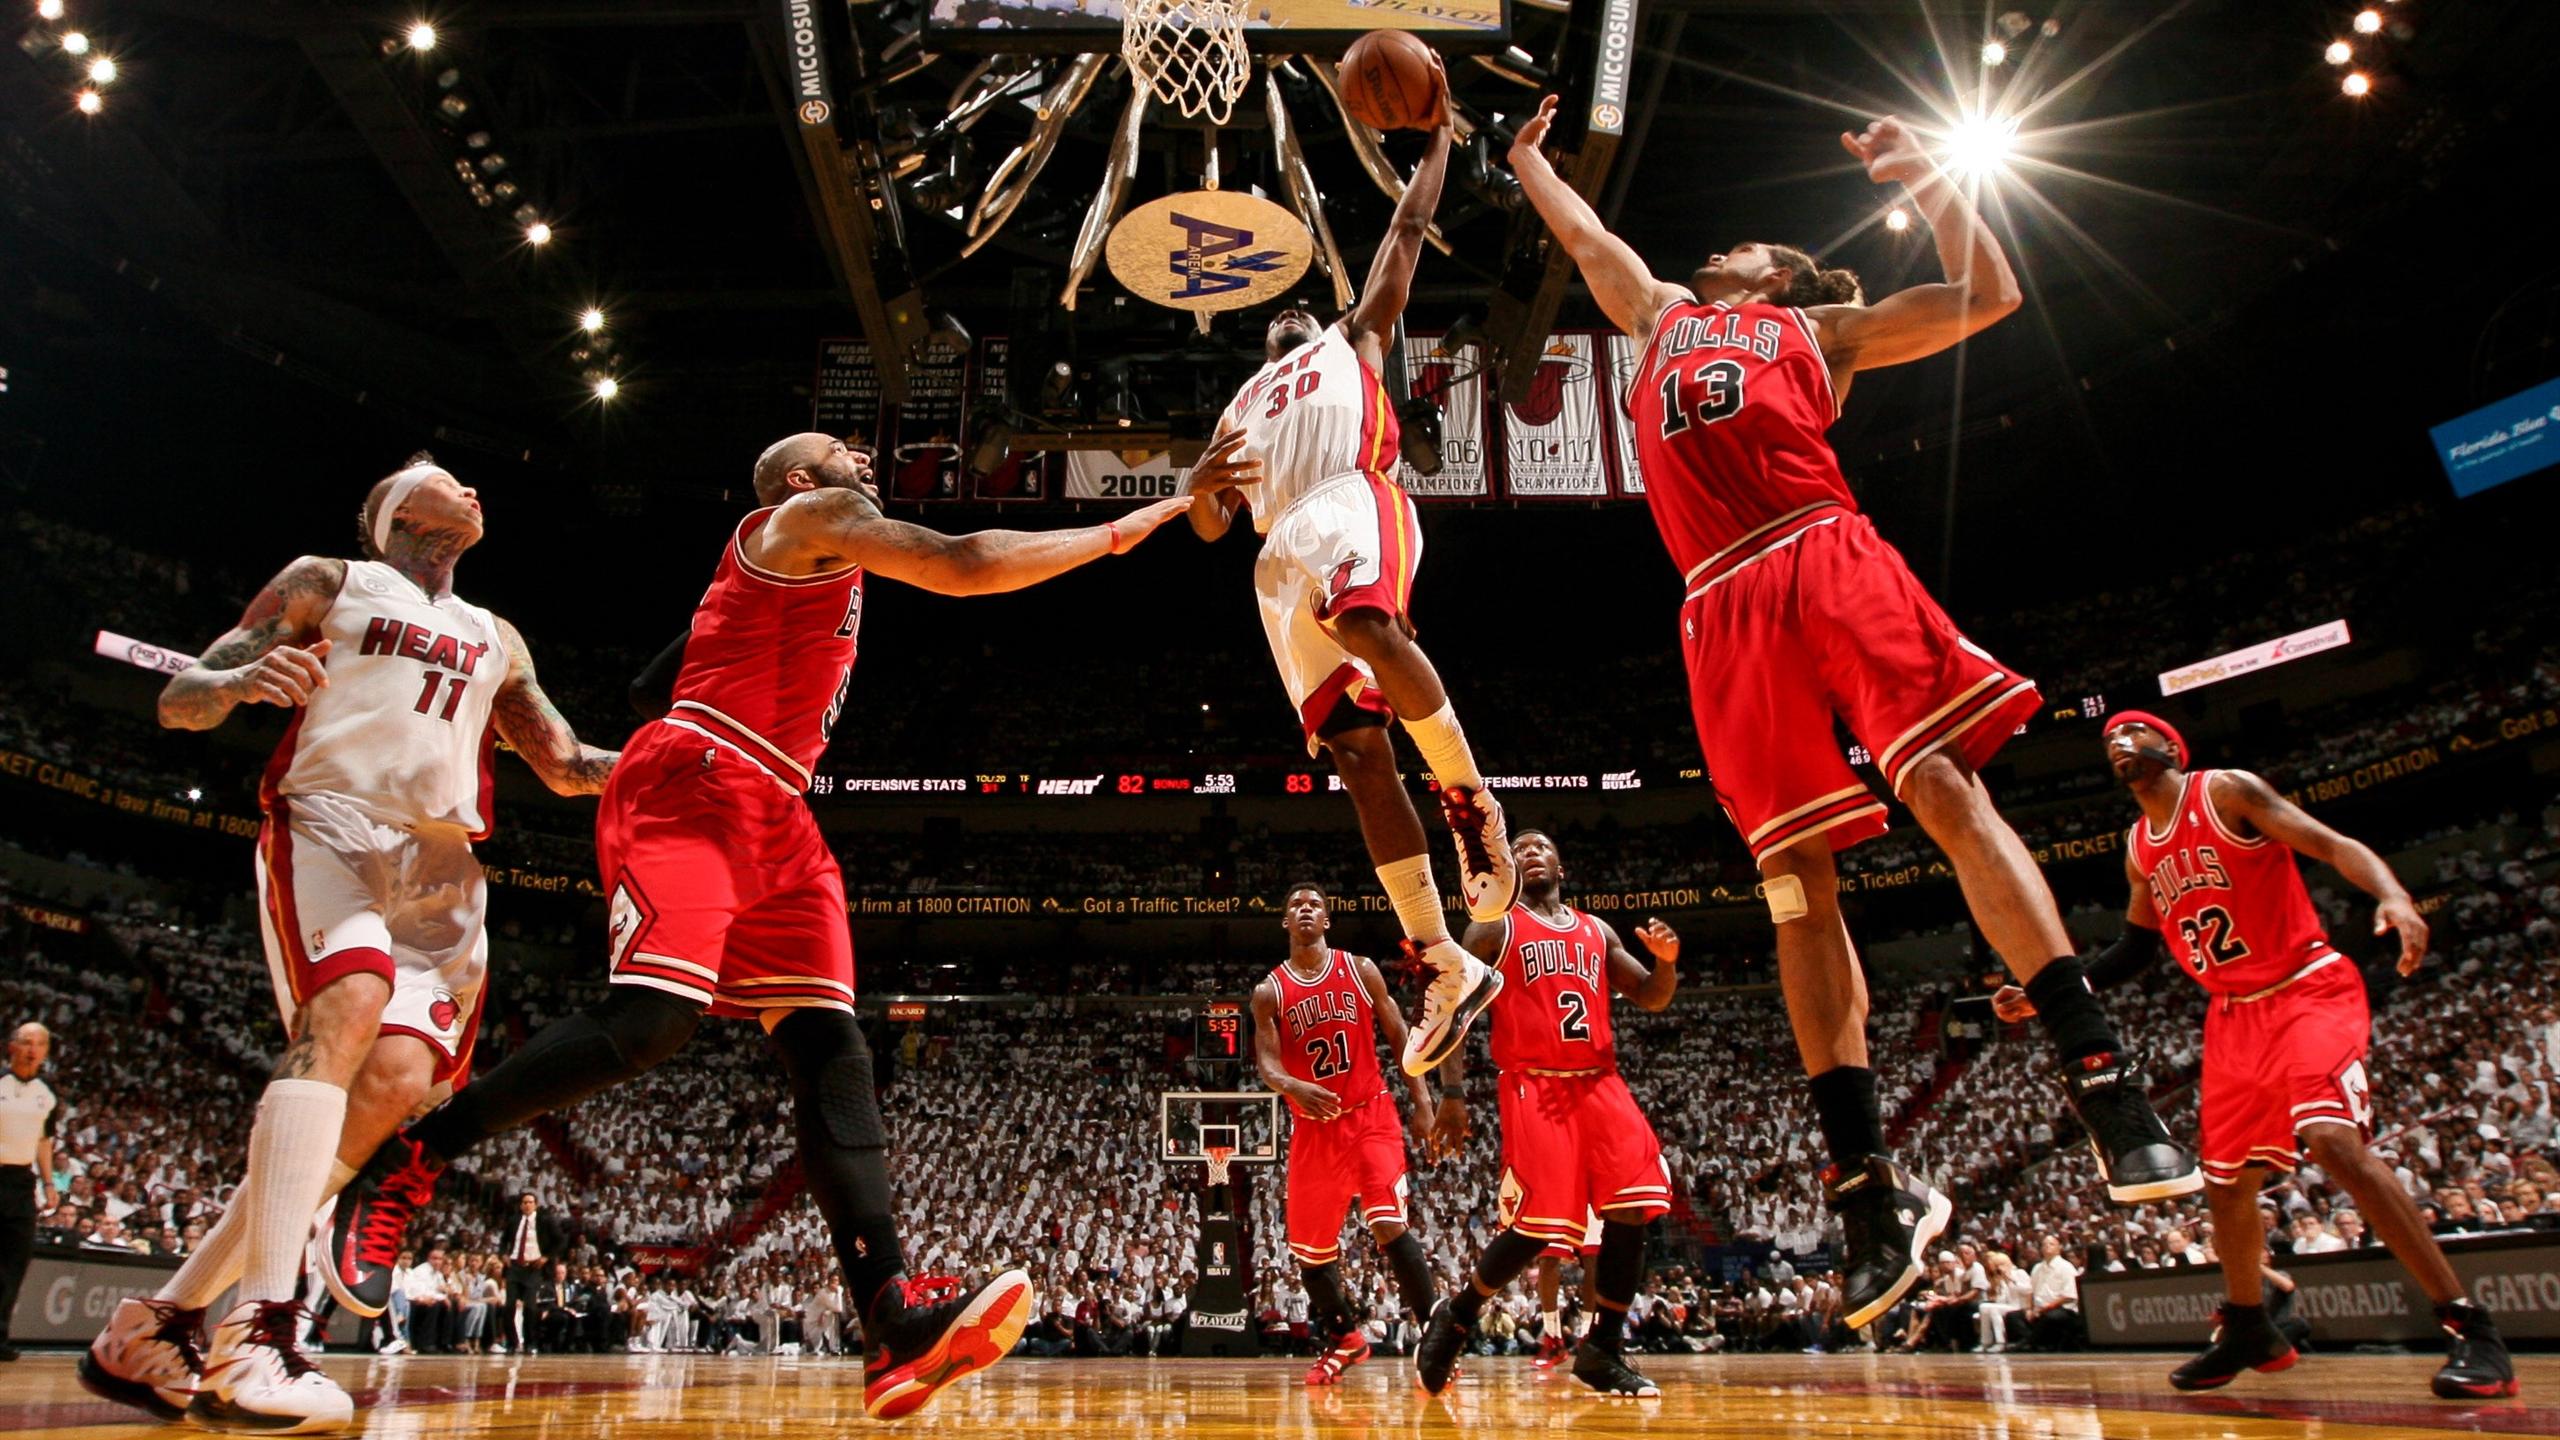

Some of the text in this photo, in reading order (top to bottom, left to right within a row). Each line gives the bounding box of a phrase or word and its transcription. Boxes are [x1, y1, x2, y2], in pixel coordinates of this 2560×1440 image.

[789, 0, 822, 96] MICCOSU
[1600, 0, 1632, 102] MICCOSU
[1187, 245, 1201, 280] ARENA
[1652, 313, 1782, 376] BULLS
[1234, 341, 1326, 421] HEAT
[1265, 370, 1321, 419] 30
[1660, 359, 1745, 441] 13
[1101, 474, 1176, 497] 2006
[1515, 477, 1599, 489] CHAMPIONS
[360, 617, 489, 677] HEAT
[413, 670, 469, 723] 11
[814, 775, 833, 785] 74.1
[846, 779, 920, 791] OFFENSIVE
[922, 779, 967, 791] STATS
[1037, 774, 1104, 795] HEAT
[1118, 775, 1144, 793] 82
[1153, 779, 1191, 790] BONUS
[1205, 774, 1235, 786] 5:53
[814, 784, 834, 794] 72.7
[1193, 785, 1229, 794] QUARTER
[1286, 774, 1312, 793] 83
[1480, 776, 1541, 788] FFENSIVE
[1544, 776, 1588, 788] STATS
[1602, 770, 1636, 781] HEAT
[1602, 779, 1641, 790] BULLS
[2305, 775, 2350, 802] 1800
[2353, 746, 2441, 790] CITATION
[38, 762, 98, 798] CLINIC
[116, 789, 146, 812] law
[152, 800, 190, 823] firm
[194, 809, 214, 829] at
[218, 814, 259, 839] 1800
[2052, 832, 2118, 860] TICKET
[509, 867, 569, 893] Ticket?
[1861, 866, 1920, 890] Ticket?
[2149, 846, 2232, 919] BULLS
[862, 898, 892, 913] firm
[897, 899, 912, 913] at
[917, 898, 951, 913] 1800
[957, 898, 1031, 913] CITATION
[1084, 898, 1111, 913] Got
[1116, 901, 1125, 913] a
[1130, 898, 1179, 913] Traffic
[1183, 898, 1241, 913] Ticket?
[1328, 896, 1357, 911] The
[1584, 894, 1619, 910] 1800
[1626, 888, 1701, 909] CITATION
[2178, 904, 2251, 974] 32
[1519, 940, 1601, 995] BULLS
[889, 1007, 926, 1016] BACARDI
[1209, 1019, 1237, 1032] 5:53
[1286, 991, 1358, 1042] BULLS
[1557, 990, 1590, 1042] 2
[1221, 1033, 1236, 1056] 7
[1306, 1030, 1351, 1082] 21
[1206, 1267, 1231, 1276] NBA TV
[2289, 1281, 2409, 1319] ATORADE
[1197, 1314, 1247, 1327] PLAYOFFS
